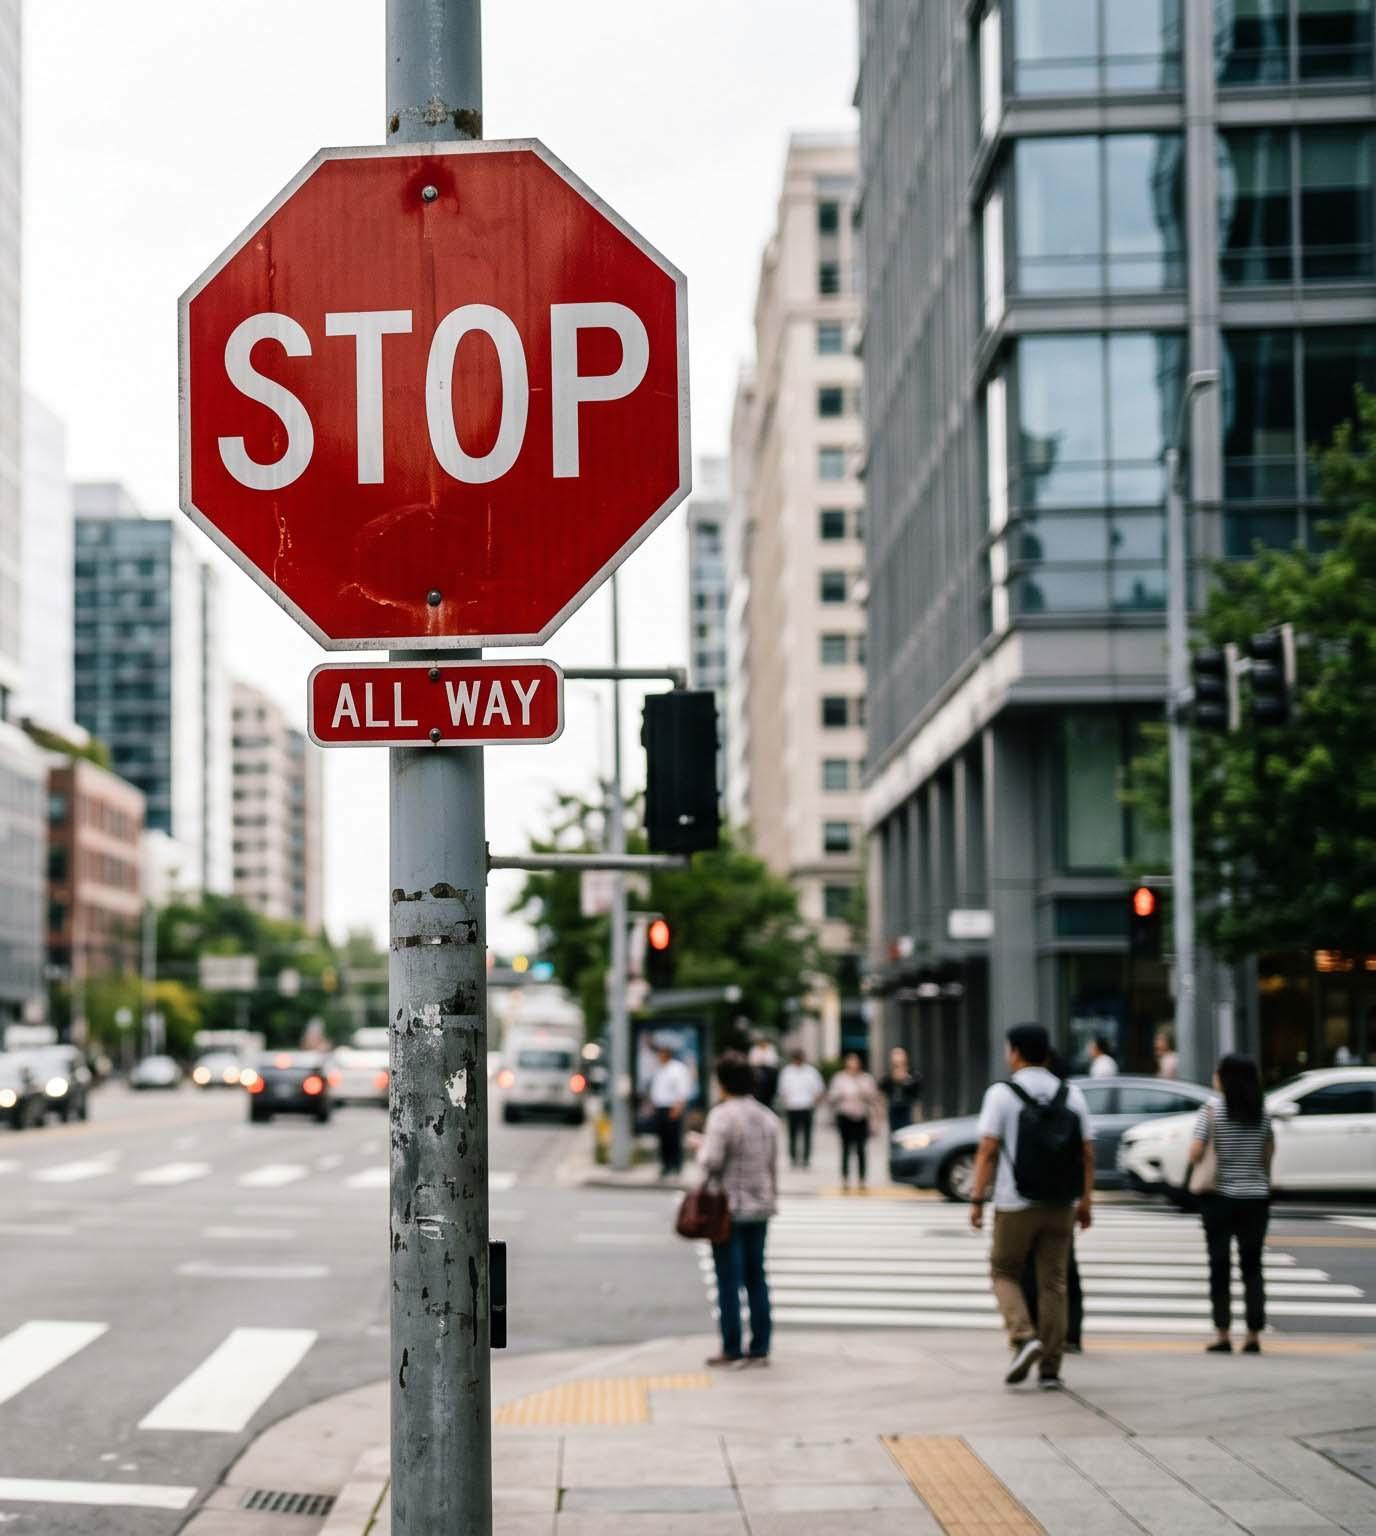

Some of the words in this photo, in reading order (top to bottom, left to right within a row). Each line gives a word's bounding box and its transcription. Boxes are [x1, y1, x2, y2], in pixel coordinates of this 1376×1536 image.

[217, 301, 650, 491] STOP
[331, 681, 419, 729] ALL
[445, 679, 541, 727] WAY
